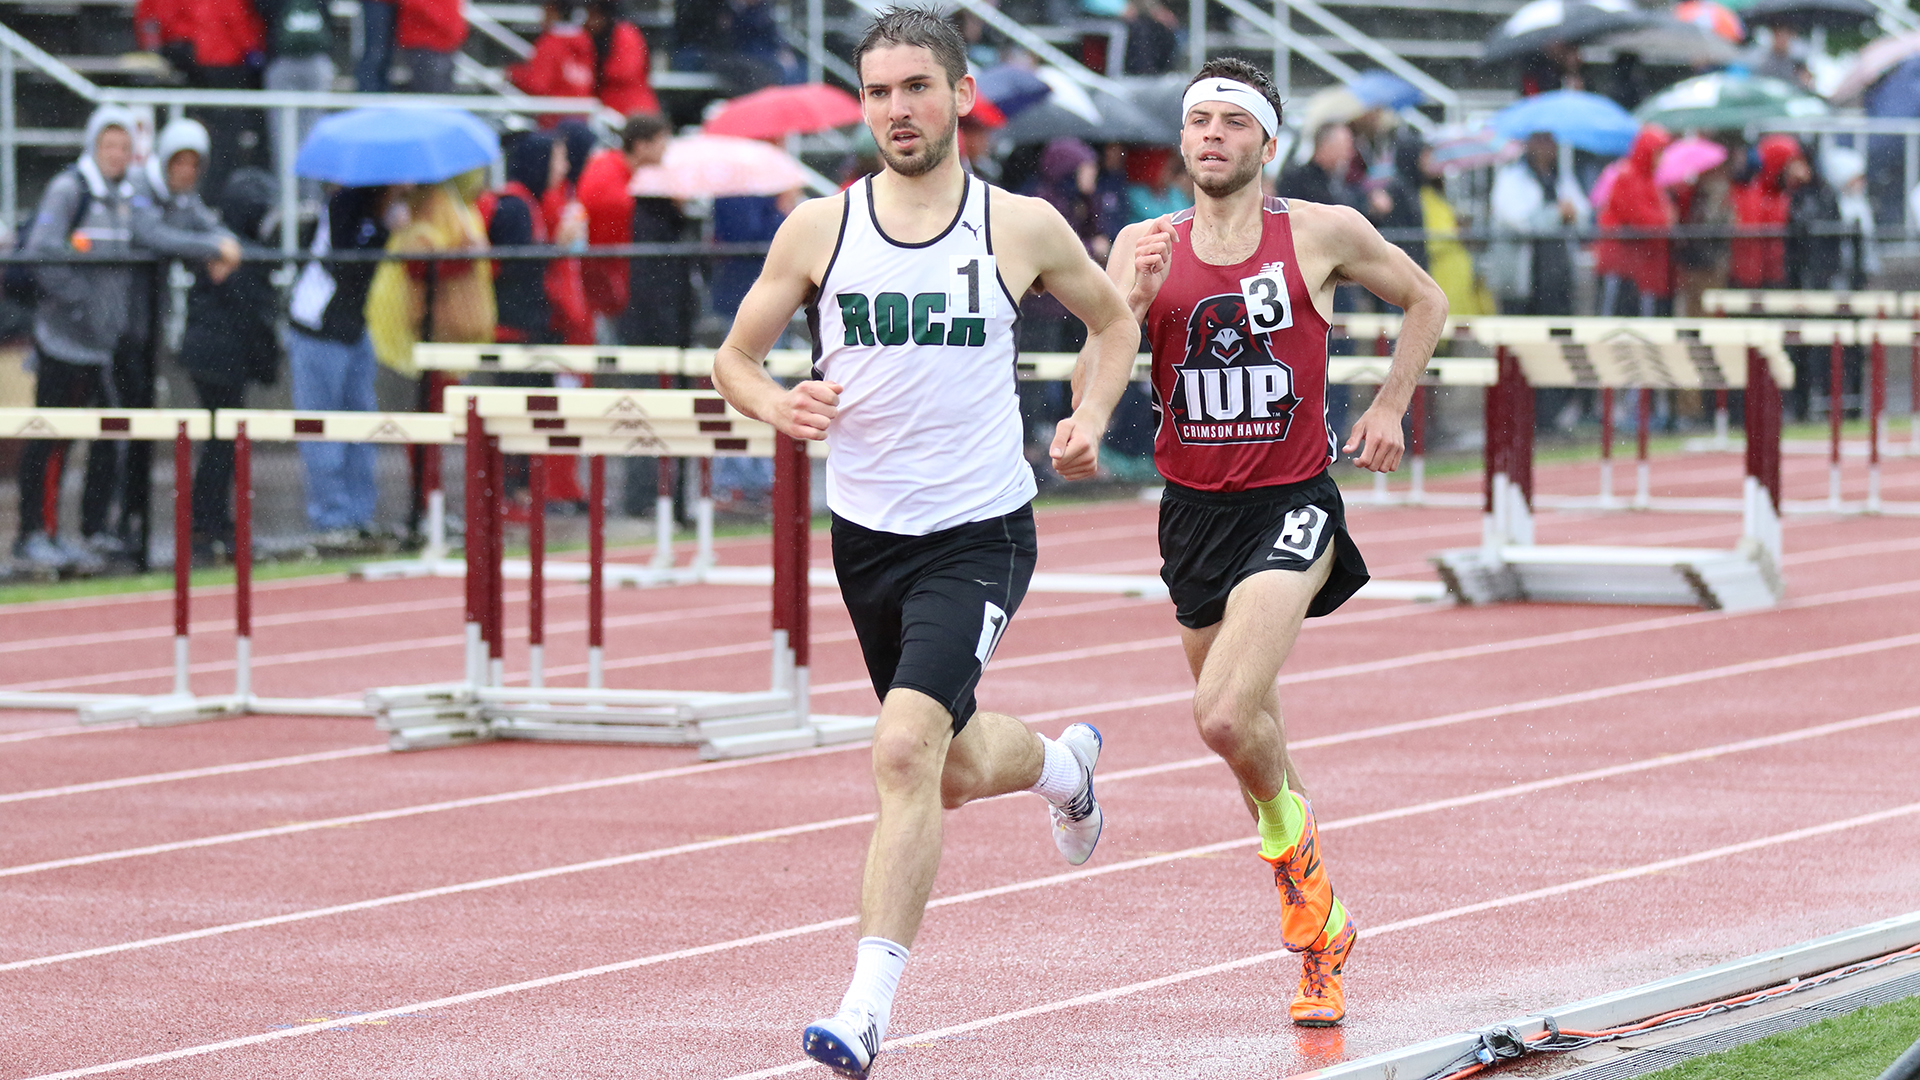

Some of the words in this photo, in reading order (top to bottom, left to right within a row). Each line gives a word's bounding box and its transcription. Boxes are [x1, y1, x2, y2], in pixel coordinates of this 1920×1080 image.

[957, 259, 980, 314] 1
[1249, 277, 1284, 329] 3
[1180, 364, 1289, 421] IUP
[1183, 424, 1233, 438] CRIMSON
[1237, 422, 1281, 436] HAWKS
[1282, 506, 1319, 551] 3
[983, 614, 1005, 664] 1
